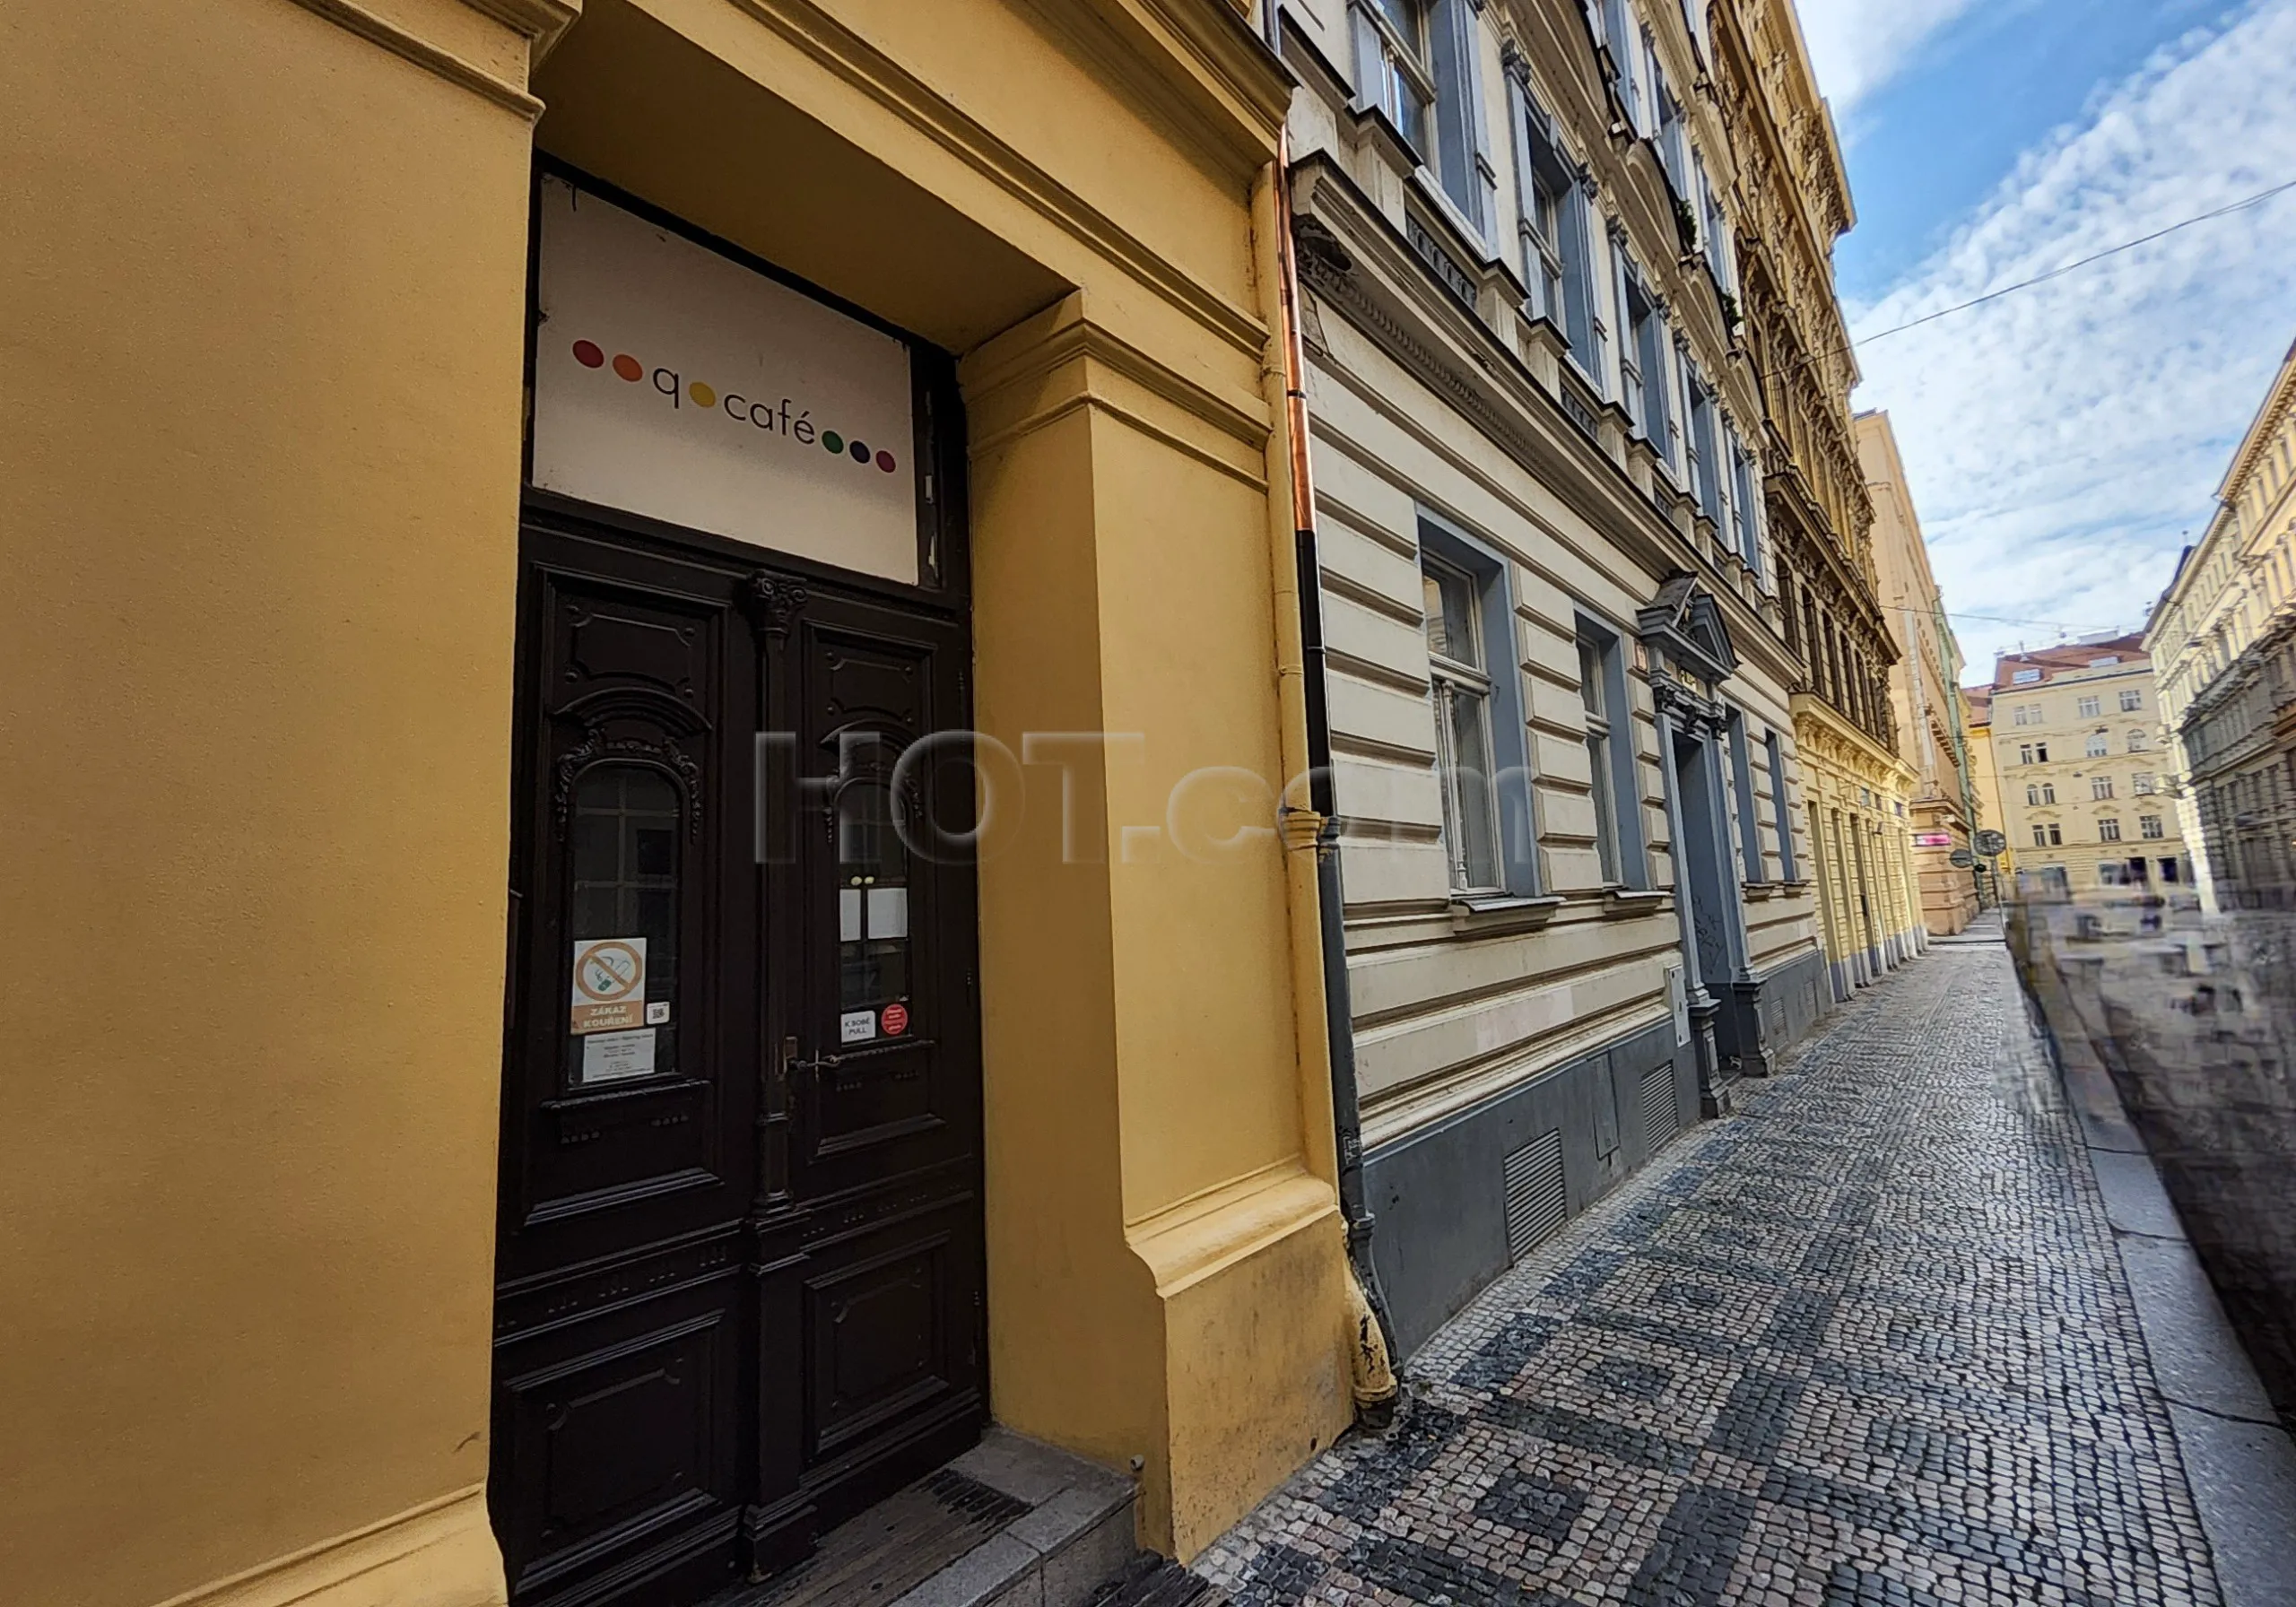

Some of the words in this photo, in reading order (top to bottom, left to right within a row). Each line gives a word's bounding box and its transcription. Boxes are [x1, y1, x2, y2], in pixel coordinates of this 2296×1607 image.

[652, 367, 680, 409] q
[724, 398, 815, 445] café
[590, 1005, 627, 1016] ZÁKAZ
[584, 1014, 633, 1028] KOUŘENÍ
